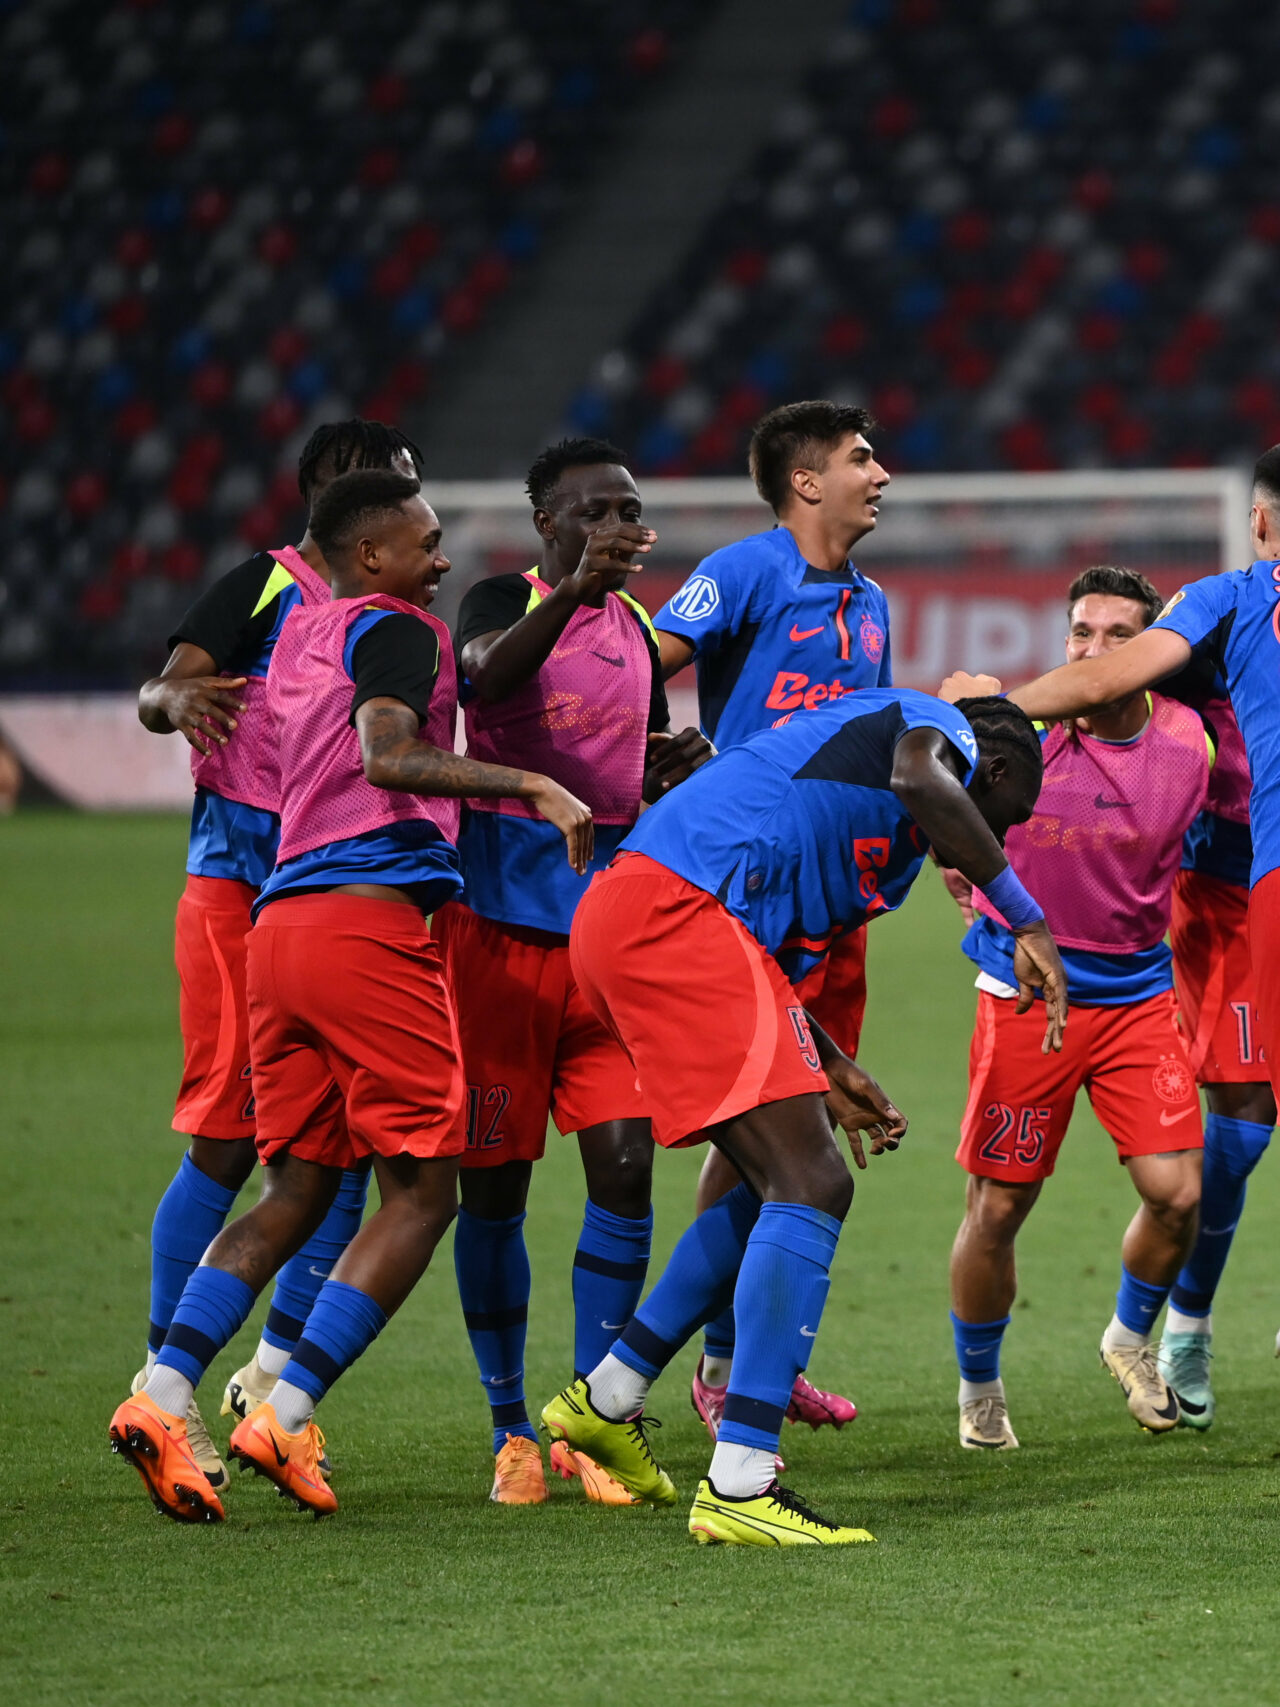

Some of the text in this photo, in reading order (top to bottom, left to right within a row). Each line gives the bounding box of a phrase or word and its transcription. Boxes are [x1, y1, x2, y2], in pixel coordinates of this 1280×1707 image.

[671, 577, 718, 619] MG
[889, 597, 1070, 682] UP
[1229, 1001, 1266, 1064] 1
[465, 1085, 511, 1150] 12
[978, 1103, 1052, 1168] 25
